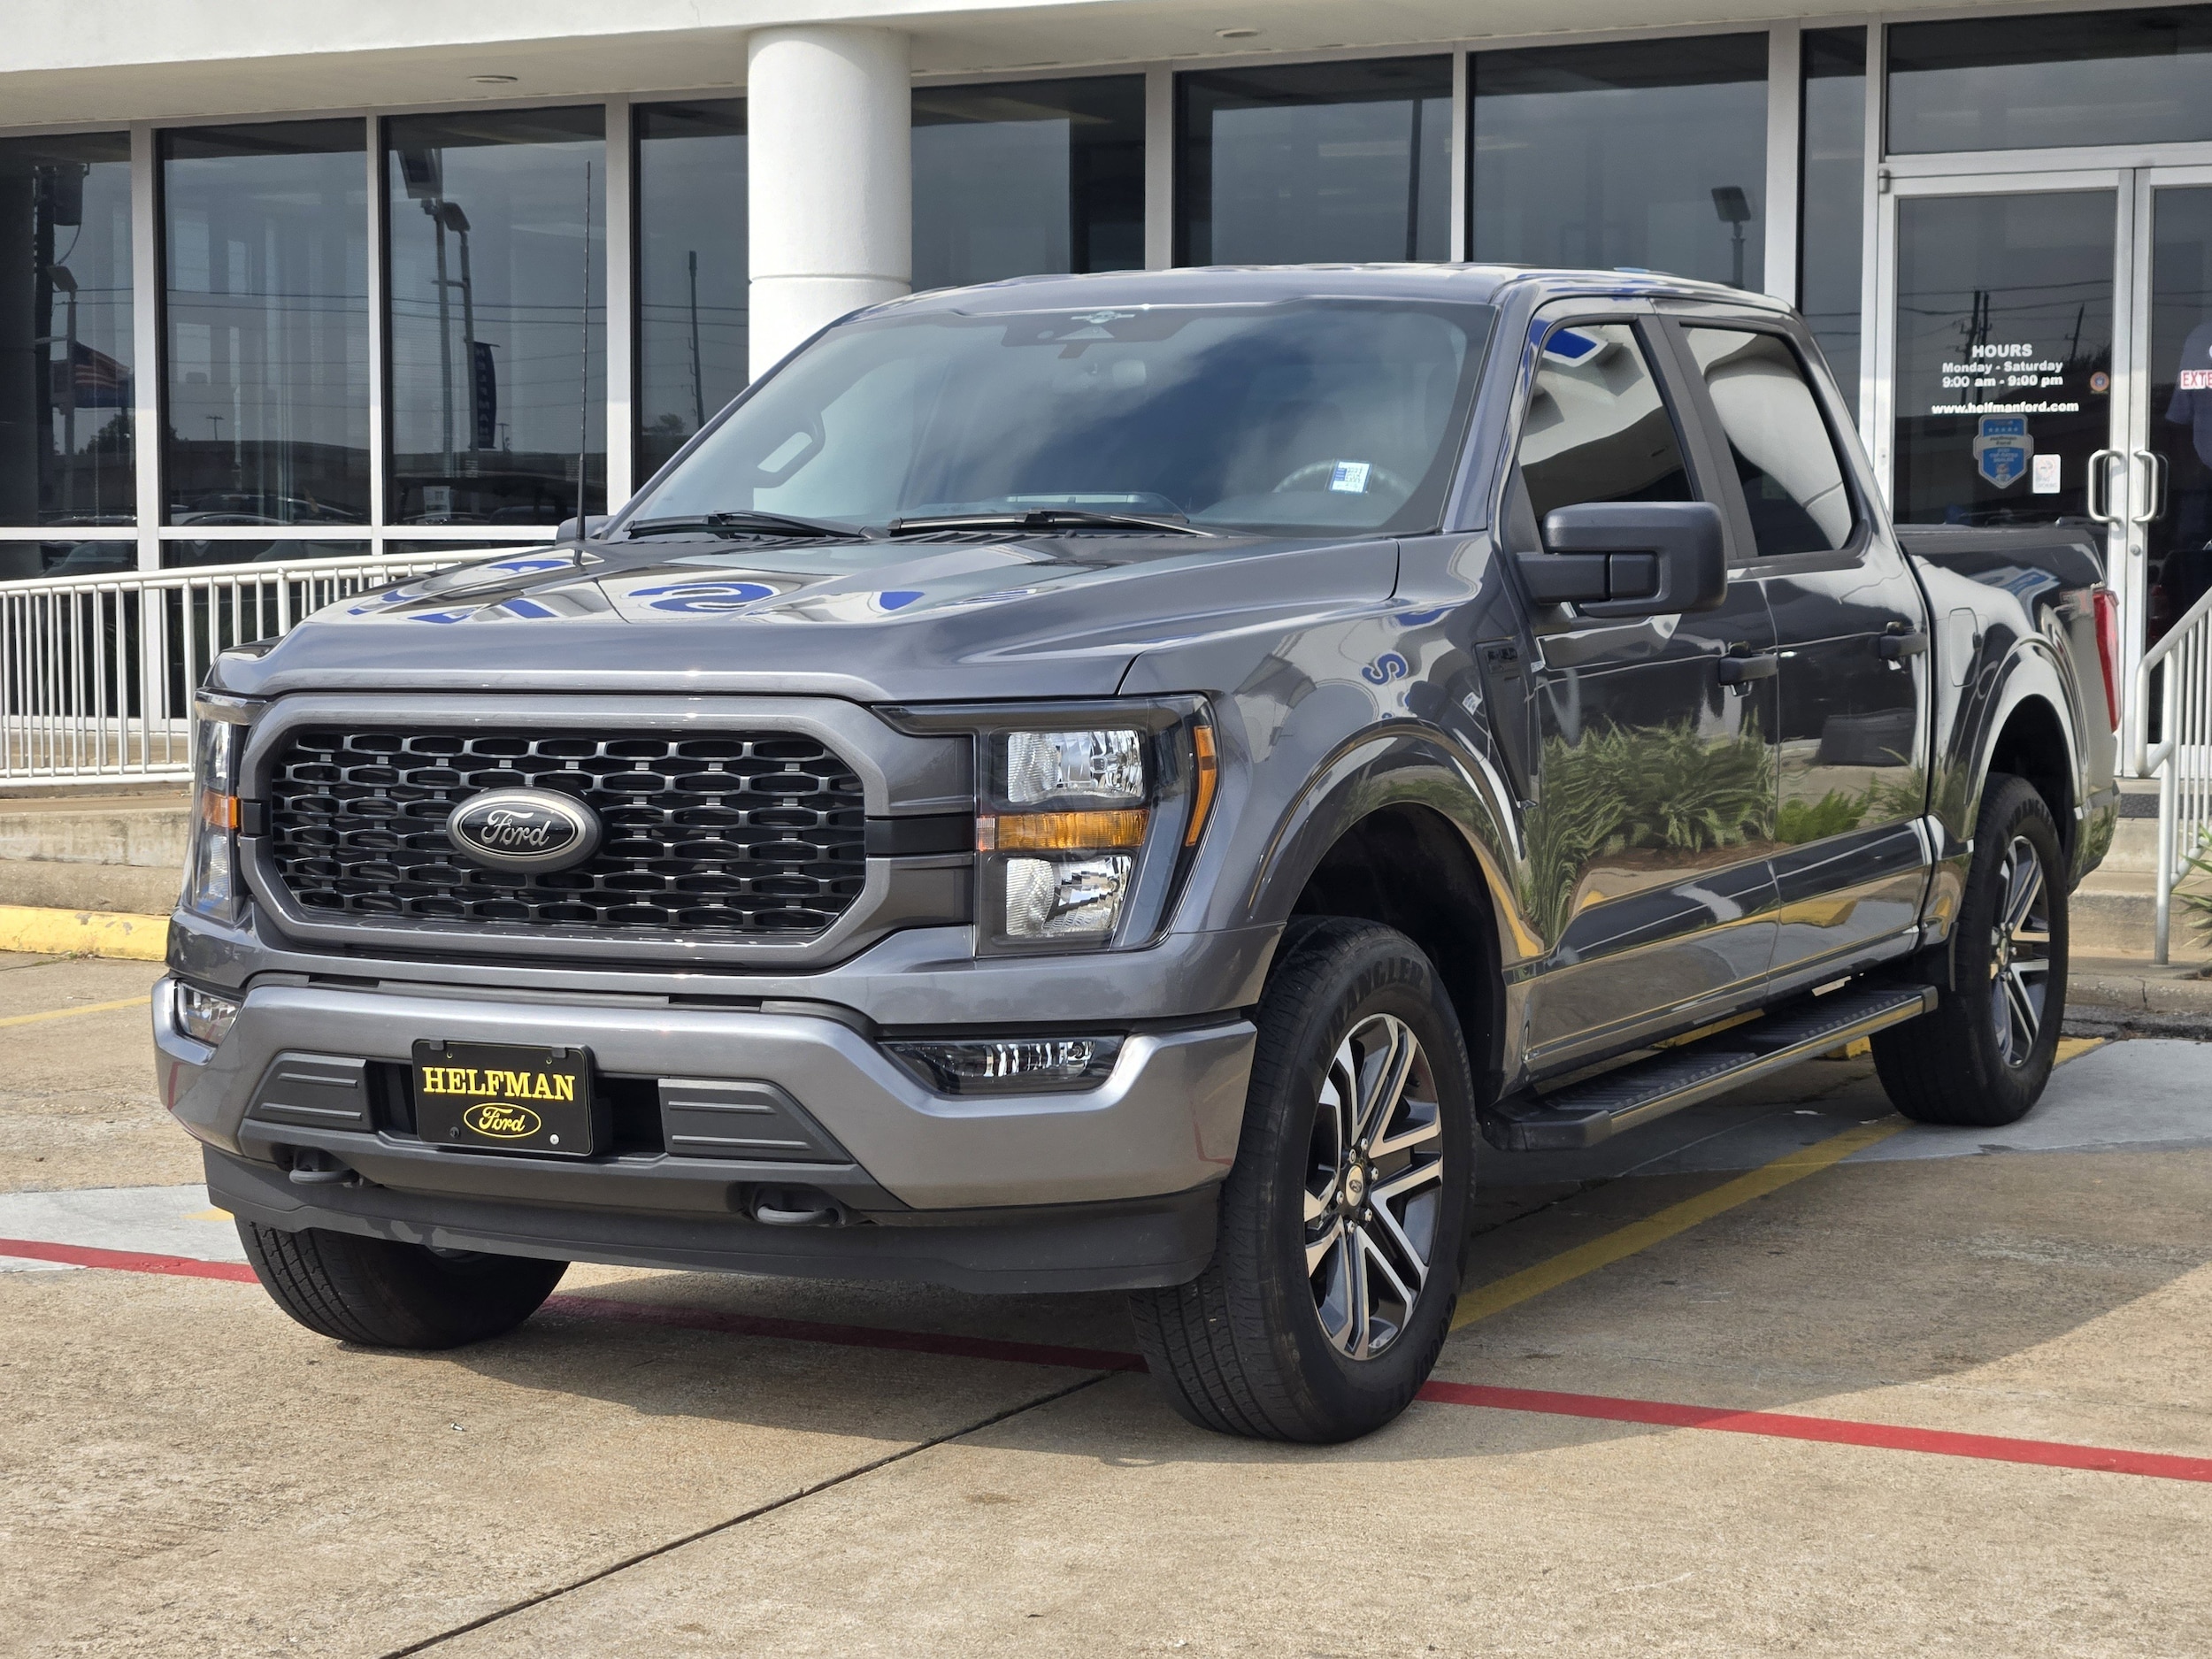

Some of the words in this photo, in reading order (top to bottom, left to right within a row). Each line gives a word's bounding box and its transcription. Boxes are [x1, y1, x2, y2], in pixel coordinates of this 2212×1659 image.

[1972, 343, 2033, 357] HOURS
[1942, 362, 1993, 374] Monday
[2003, 360, 2063, 373] Saturday
[1942, 376, 1970, 388] 9:00
[1974, 377, 1996, 387] am
[2008, 375, 2038, 387] 9:00
[2041, 376, 2063, 388] pm
[1932, 401, 2079, 414] www.helfmanford.com
[480, 809, 553, 847] Ford
[422, 1067, 575, 1101] HELFMAN
[479, 1106, 526, 1133] Ford
